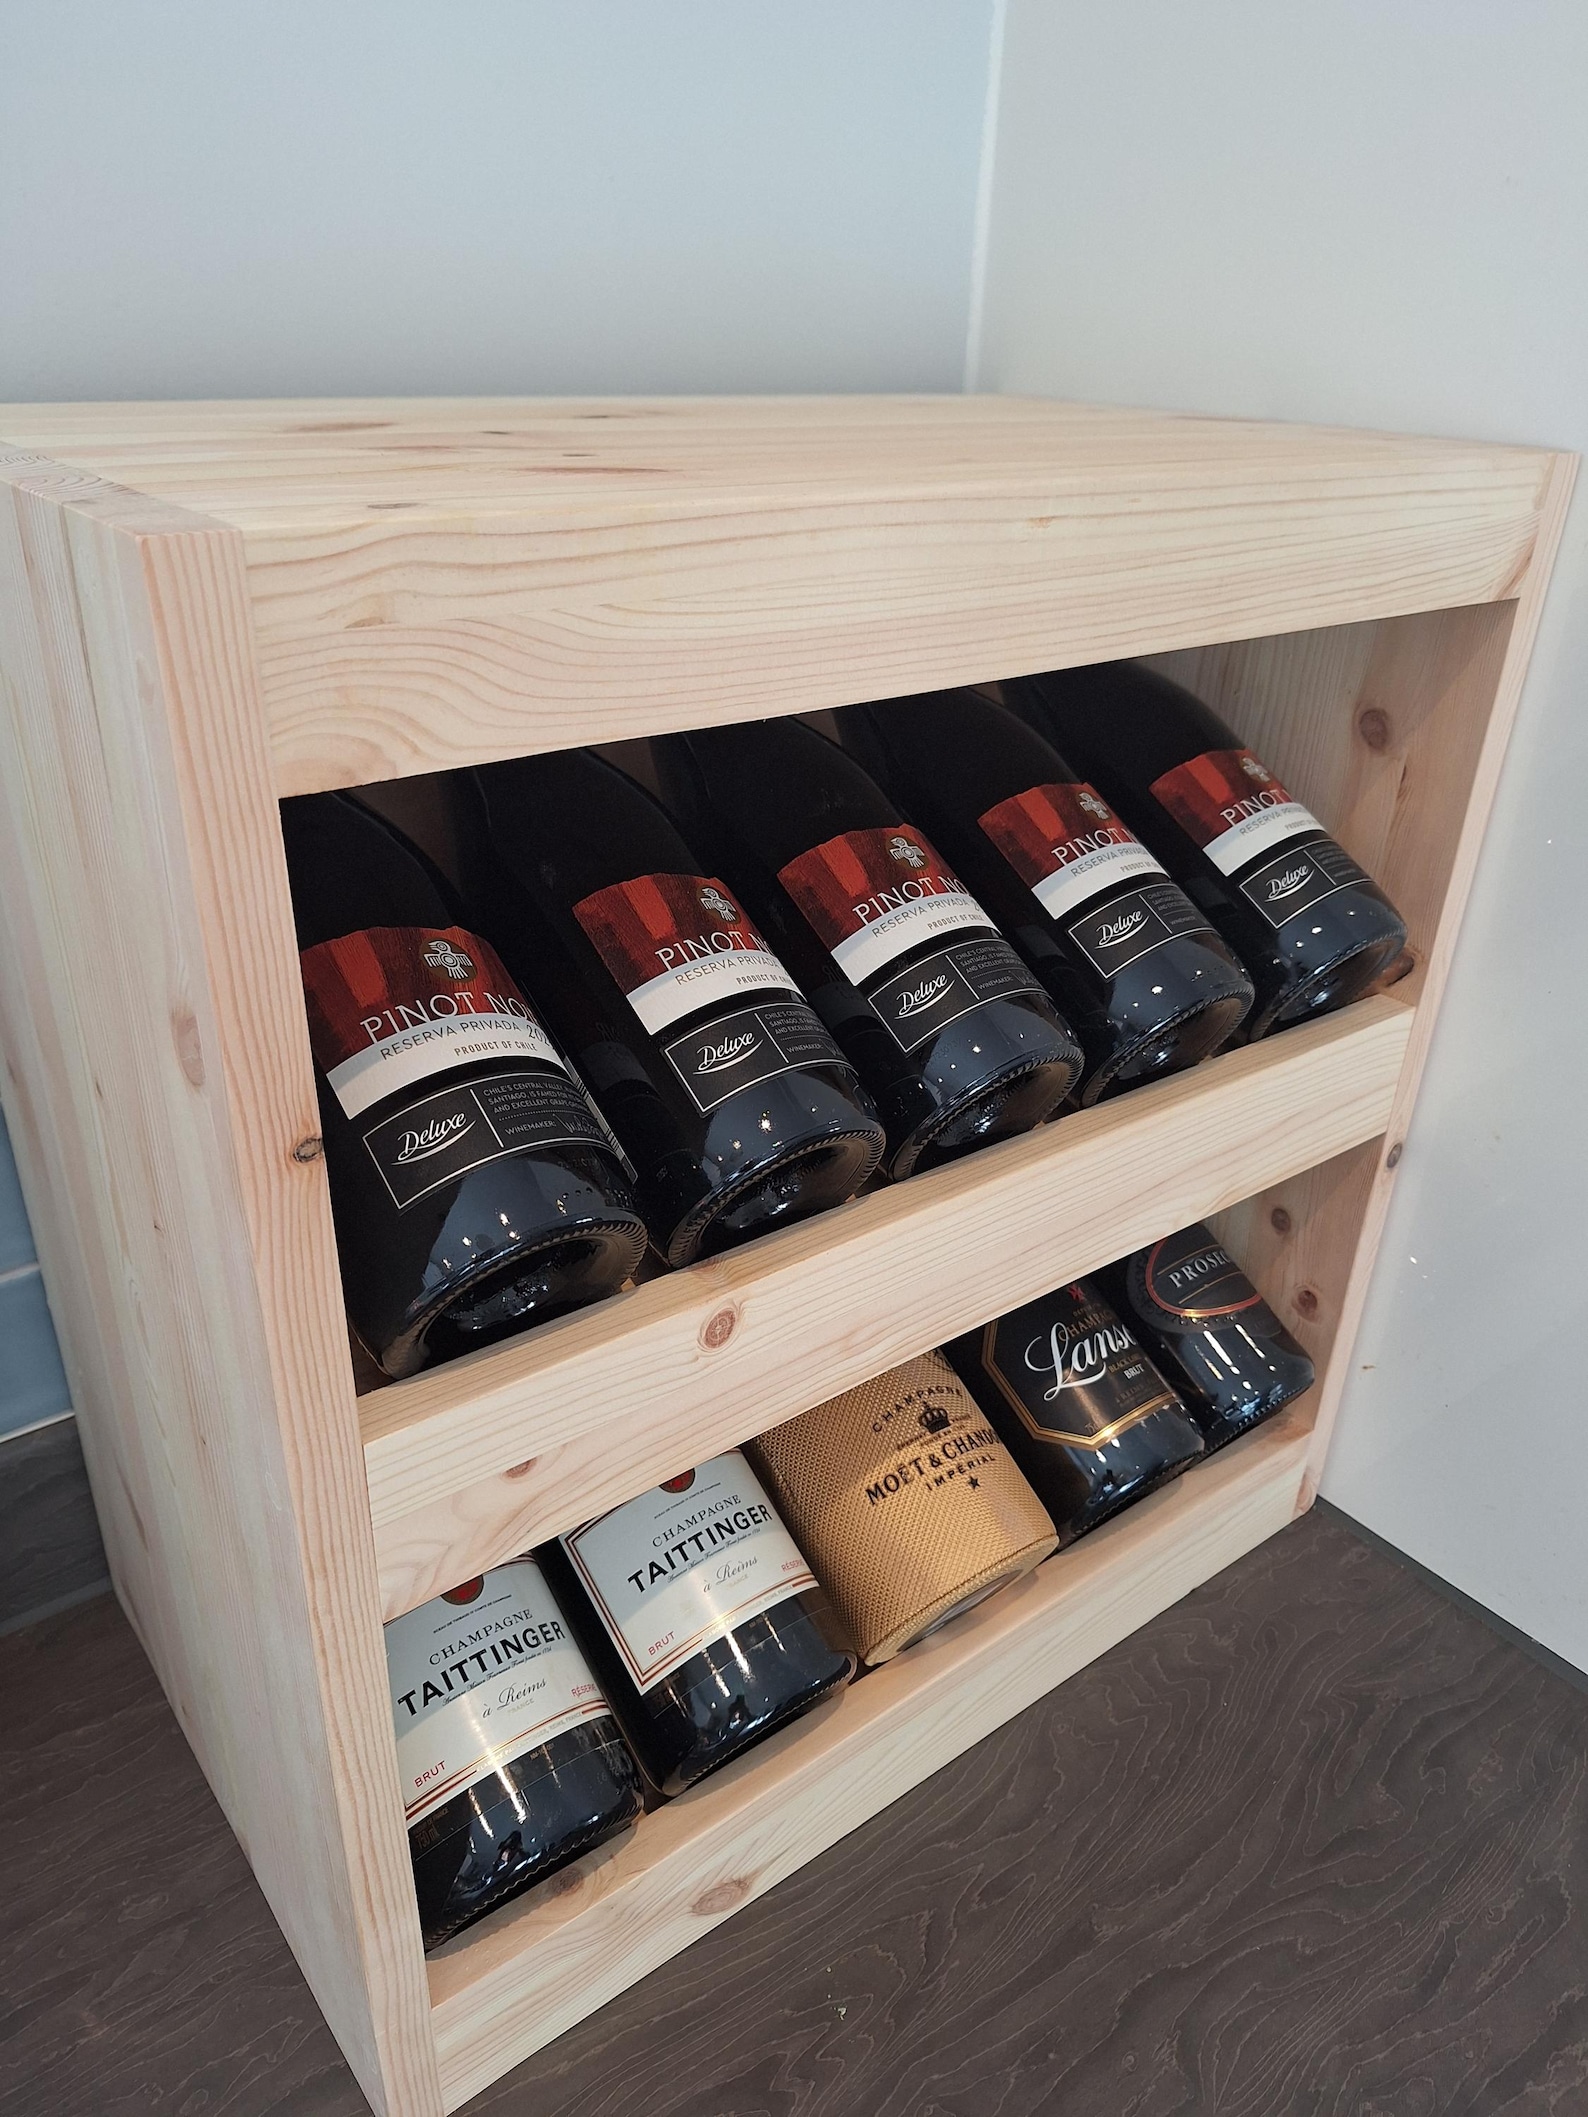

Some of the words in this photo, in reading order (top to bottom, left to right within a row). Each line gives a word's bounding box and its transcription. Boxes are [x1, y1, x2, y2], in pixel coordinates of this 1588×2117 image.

[1220, 789, 1285, 826] PINOT
[1240, 811, 1281, 836] RESERVA
[1051, 828, 1118, 866] PINOT
[1071, 852, 1118, 877] RESERVA
[1264, 864, 1309, 898] Deluxe
[852, 876, 938, 925] PINOT
[938, 876, 971, 896] NO
[872, 906, 927, 938] RESERVA
[927, 898, 969, 911] PRIVADA
[927, 915, 959, 930] PRODUCT
[1095, 909, 1144, 947] Deluxe
[655, 931, 743, 972] PINOT
[675, 958, 736, 985] RESERVA
[895, 971, 949, 1017] Deluxe
[360, 991, 474, 1043] PINOT
[380, 1025, 457, 1061] RESERVA
[460, 1020, 522, 1035] PRIVADA
[454, 1040, 500, 1056] PRODUCT
[502, 1040, 512, 1049] OF
[514, 1040, 538, 1051] CHILE
[695, 1031, 757, 1073] Deluxe
[483, 1084, 512, 1097] CHILE'S
[513, 1082, 544, 1091] CENTRAL
[488, 1092, 529, 1105] SANTIAGO,
[494, 1104, 511, 1113] AND
[511, 1099, 549, 1109] EXCELLENT
[394, 1110, 469, 1163] Deluxe
[505, 1120, 557, 1135] WINEMAKER:
[1168, 1250, 1231, 1288] PROSEC
[1123, 1364, 1144, 1379] BRUT
[928, 1453, 943, 1468] &
[652, 1494, 742, 1548] CHAMPAGNE
[627, 1504, 773, 1592] TAITTINGER
[703, 1579, 711, 1593] à
[715, 1556, 758, 1585] Reims
[429, 1608, 533, 1666] CHAMPAGNE
[648, 1631, 675, 1656] BRUT
[397, 1621, 566, 1717] TAITTINGER
[482, 1704, 492, 1719] à
[497, 1677, 547, 1710] Reims
[415, 1760, 446, 1788] BRUT
